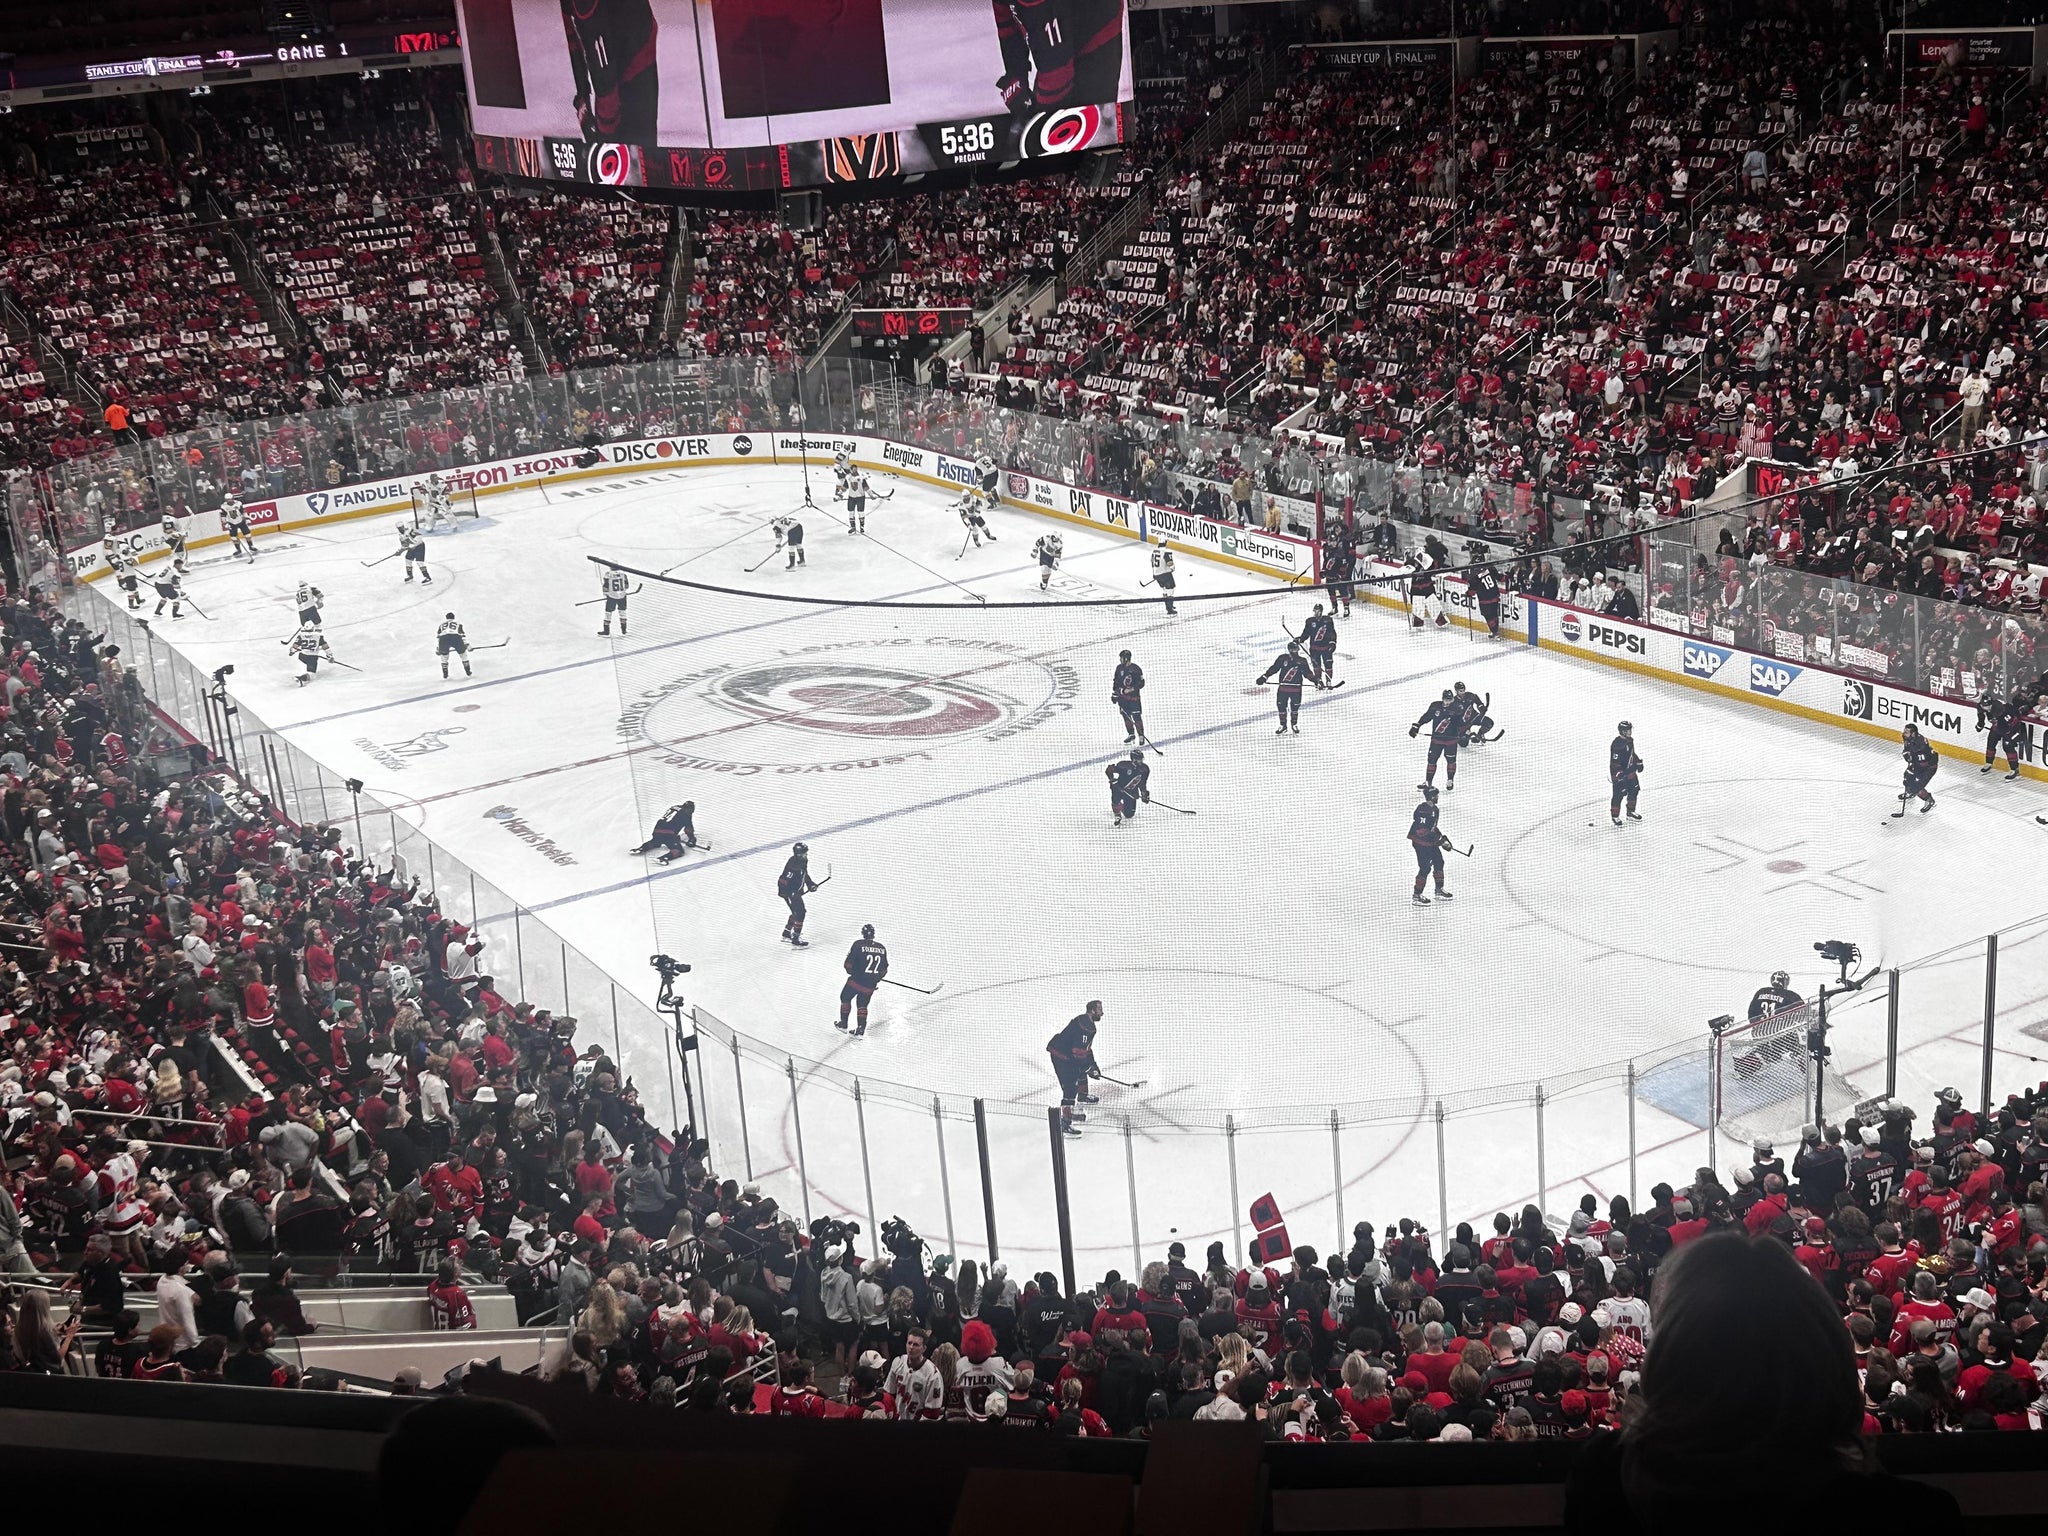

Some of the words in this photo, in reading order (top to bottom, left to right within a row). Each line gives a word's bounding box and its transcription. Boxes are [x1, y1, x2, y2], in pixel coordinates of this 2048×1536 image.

[1045, 18, 1062, 47] 11
[277, 44, 326, 62] GAME
[339, 43, 349, 56] 1
[1325, 53, 1362, 64] STANLEY
[1364, 52, 1380, 64] CUP
[1395, 52, 1423, 63] FINAL
[86, 65, 125, 78] STANLEY
[126, 63, 143, 75] CUP
[158, 60, 186, 72] FINAL
[941, 122, 995, 155] 5:36
[552, 143, 577, 169] 5:36
[614, 437, 710, 464] DISCOVER
[733, 440, 753, 449] abc
[780, 438, 832, 451] theScore
[883, 442, 924, 468] Energizer
[937, 455, 977, 486] FASTEN
[334, 483, 409, 508] FANDUEL
[1069, 489, 1092, 519] CAT
[1106, 498, 1130, 529] CAT
[1226, 536, 1294, 562] enterprise
[612, 579, 625, 592] 61
[1482, 575, 1495, 591] 19
[1561, 621, 1581, 634] PEPSI
[1589, 624, 1646, 656] PEPSI
[1684, 647, 1722, 674] SAP
[1751, 663, 1791, 691] SAP
[1877, 696, 1962, 734] BETMGM
[864, 954, 881, 974] 22
[1869, 1176, 1893, 1206] 37
[1942, 1199, 1961, 1214] JARVIS
[1943, 1212, 1960, 1241] 24
[414, 1248, 441, 1275] 74
[963, 1375, 996, 1387] TYLICKI
